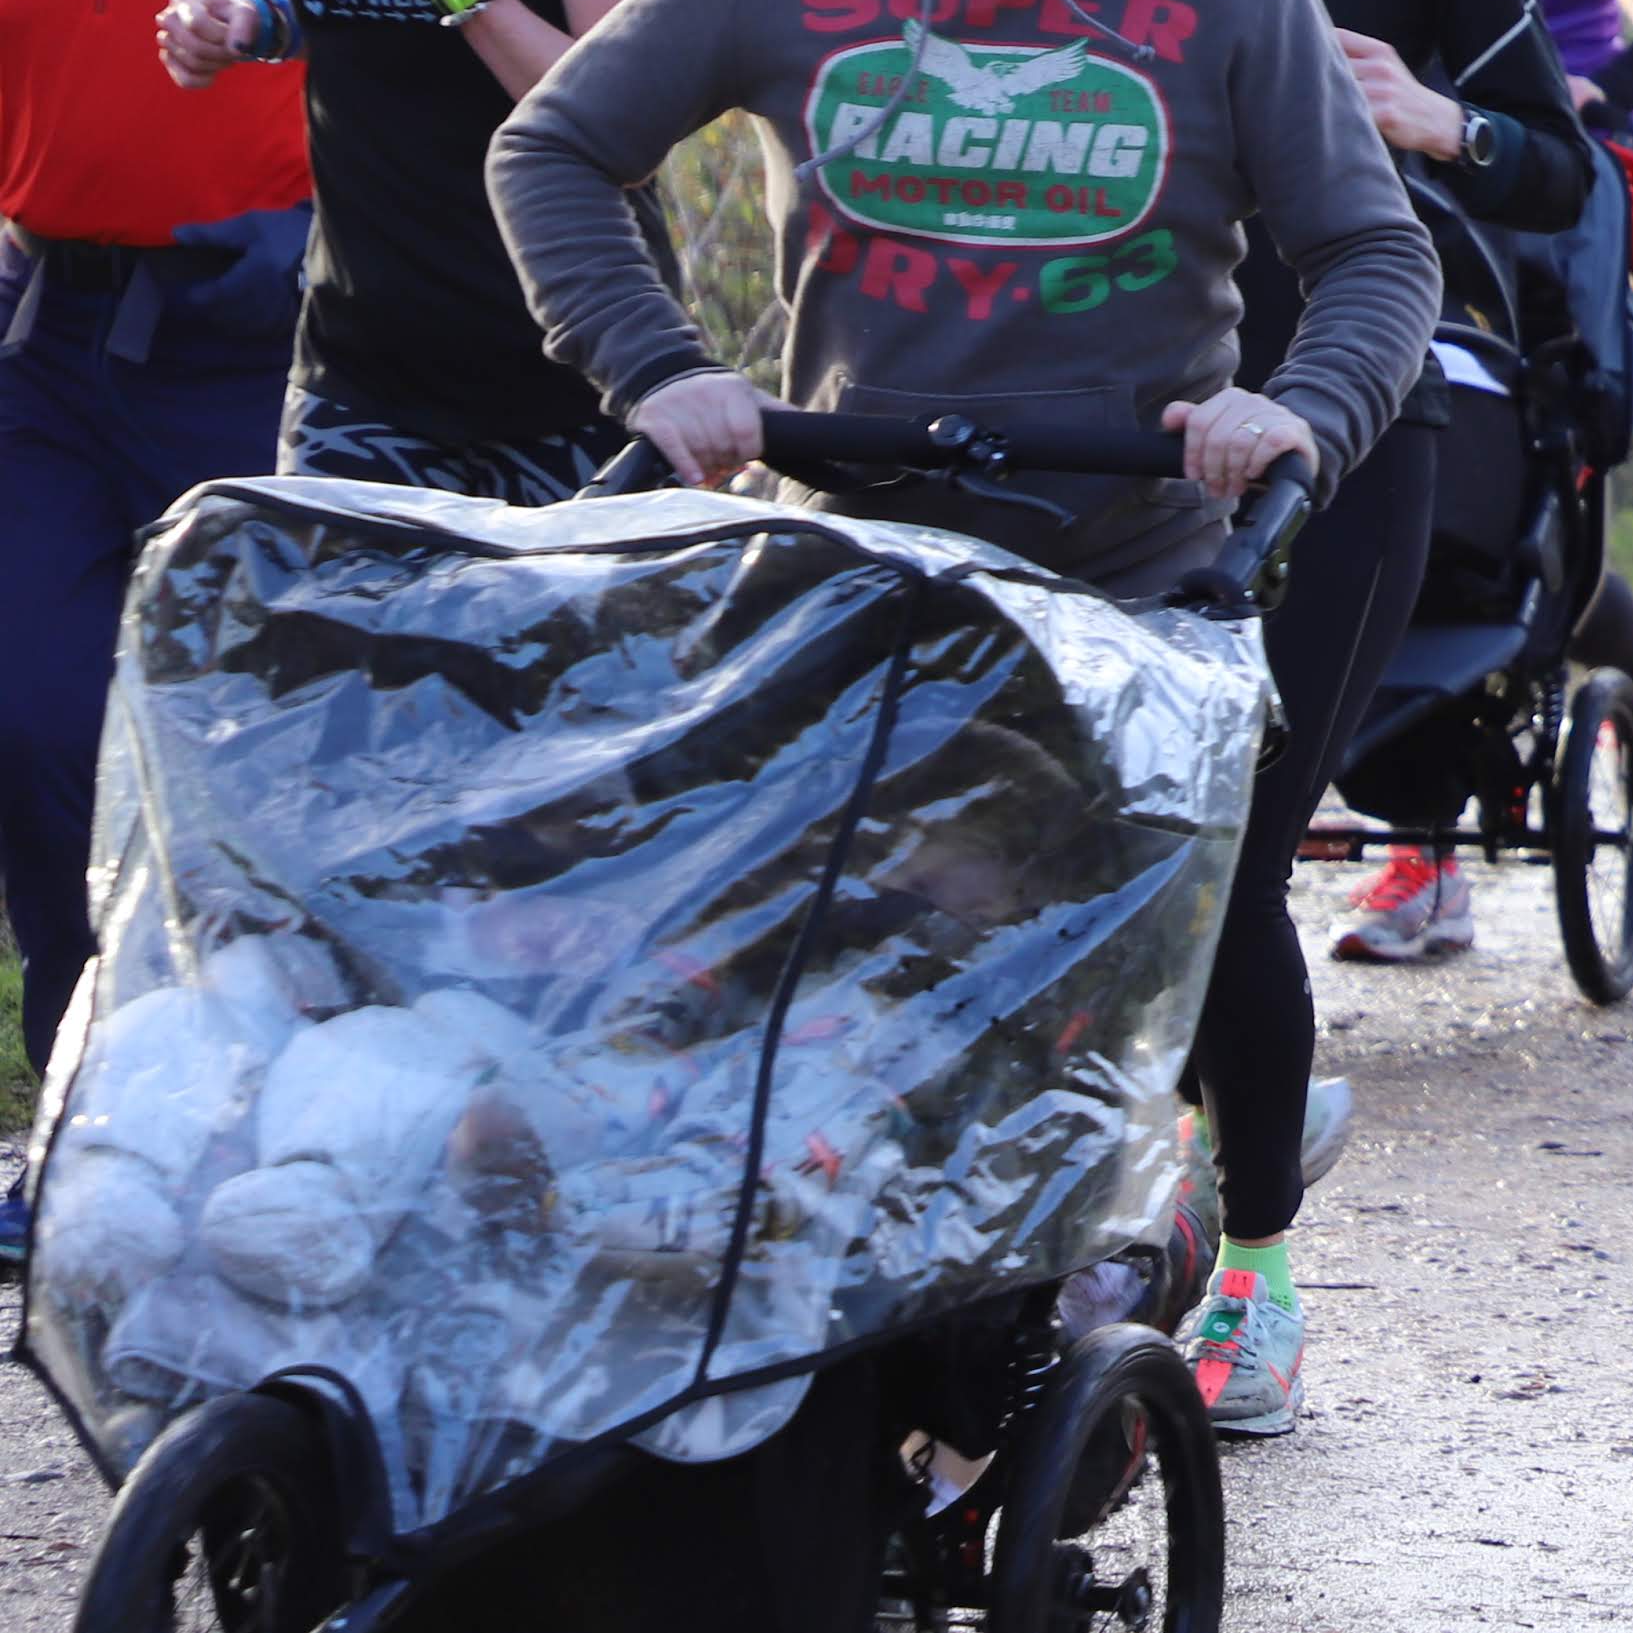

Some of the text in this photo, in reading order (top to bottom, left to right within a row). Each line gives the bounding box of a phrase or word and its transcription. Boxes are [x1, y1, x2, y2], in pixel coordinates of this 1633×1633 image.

[1049, 89, 1112, 113] TEAM
[828, 102, 1149, 178] RACING
[851, 170, 1122, 218] MOTOR OIL
